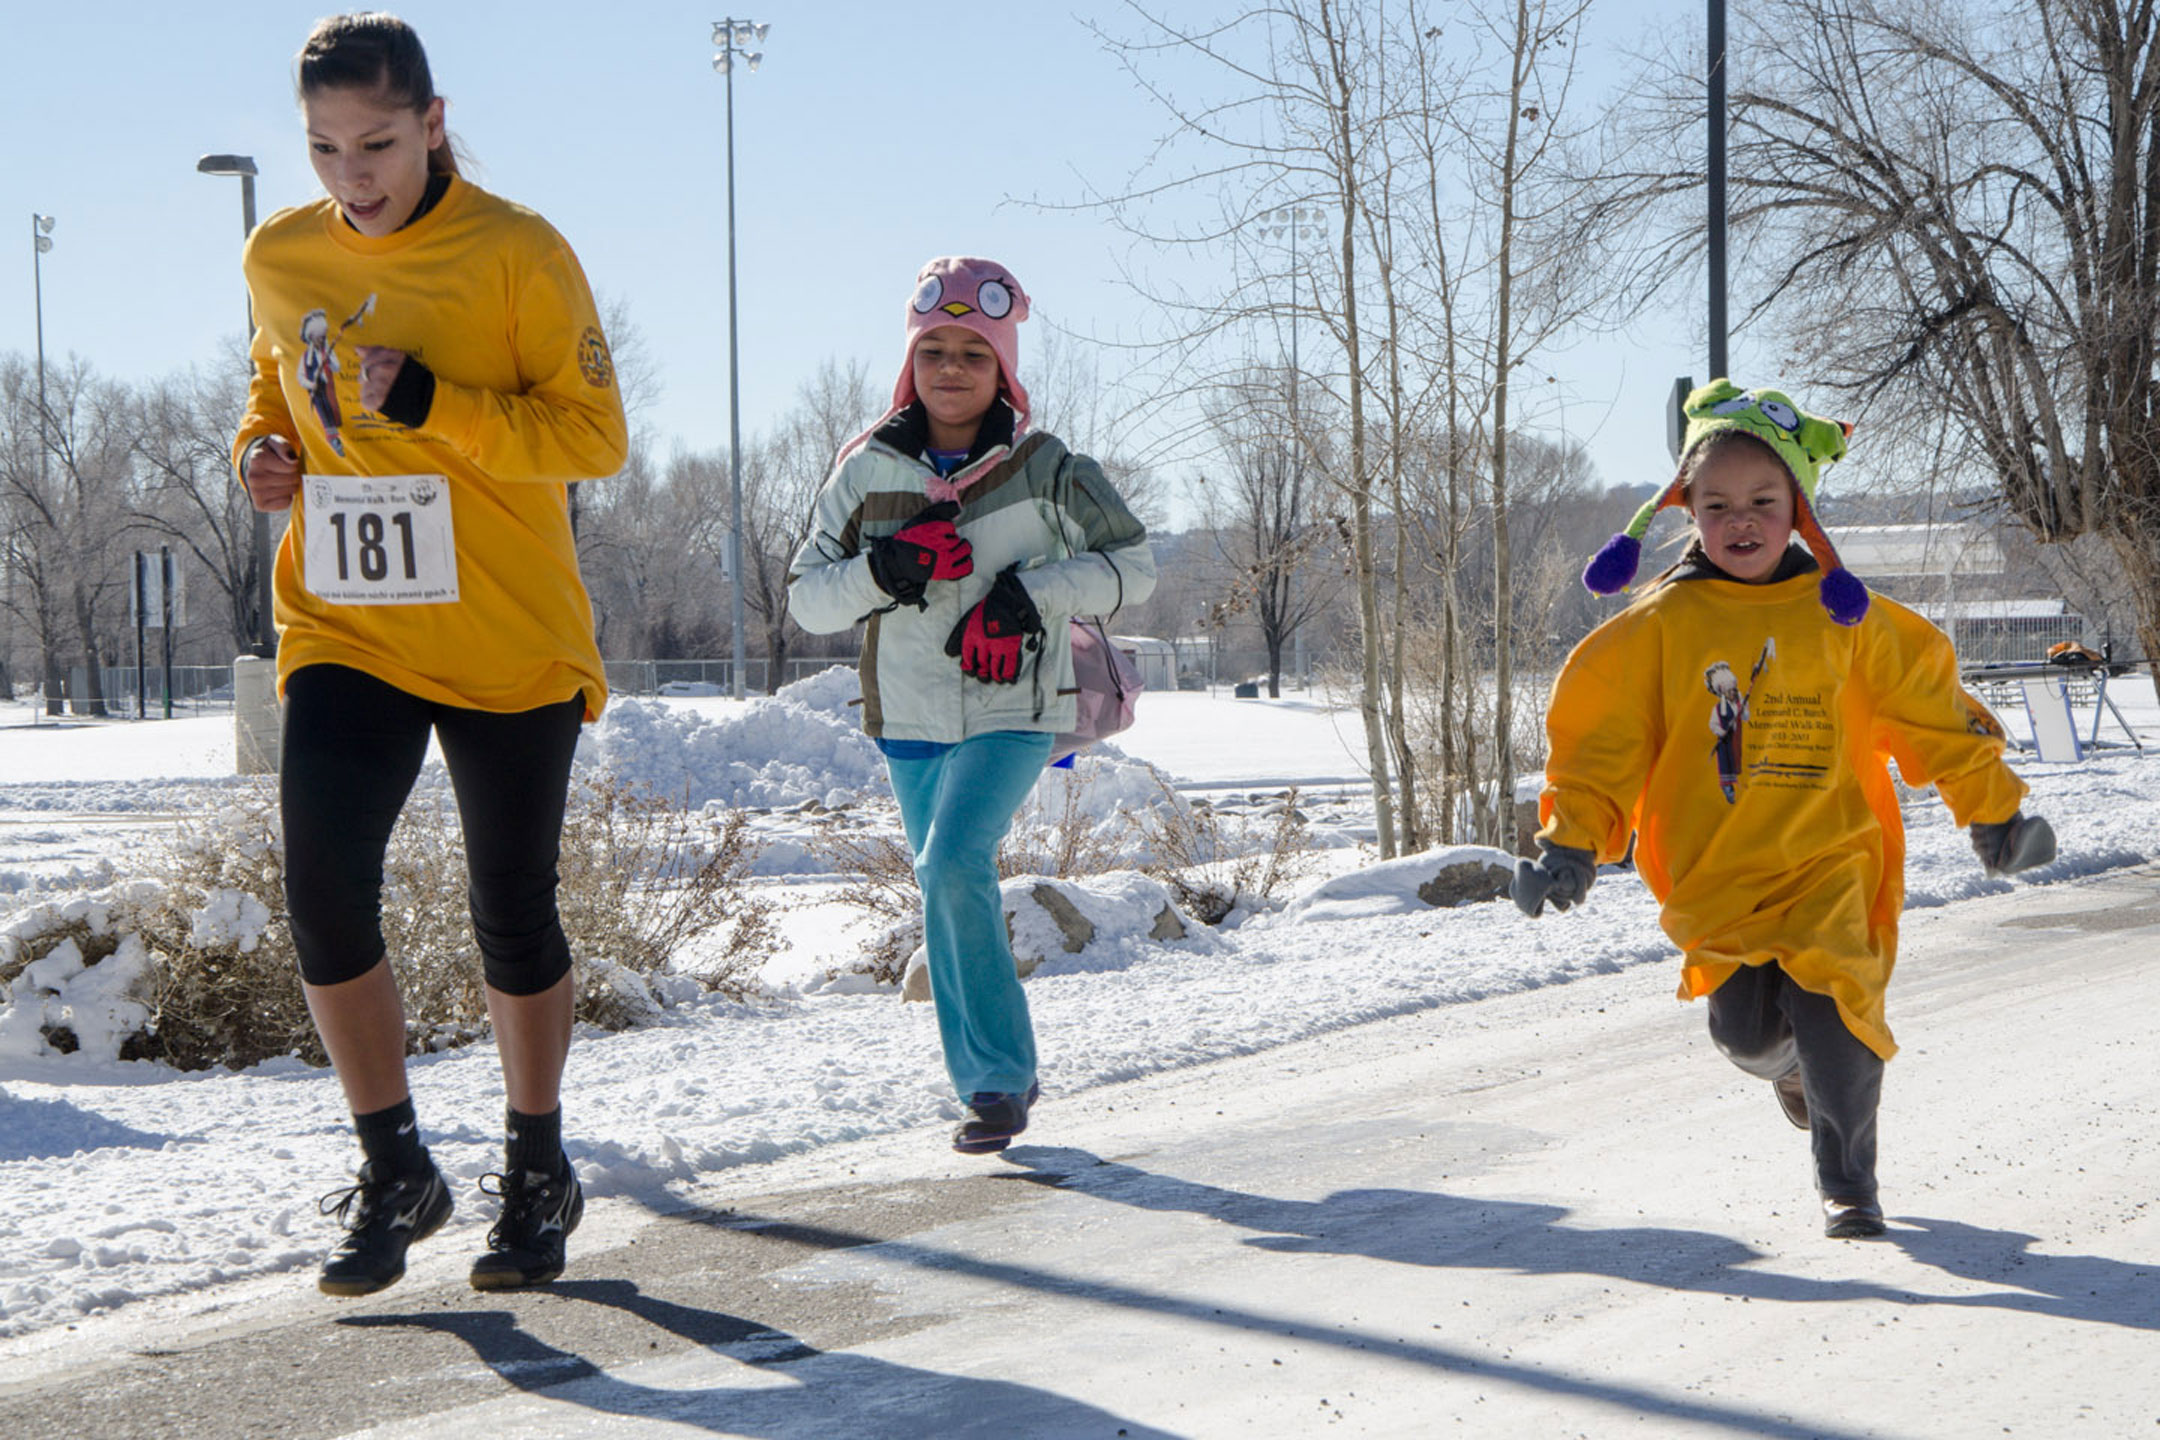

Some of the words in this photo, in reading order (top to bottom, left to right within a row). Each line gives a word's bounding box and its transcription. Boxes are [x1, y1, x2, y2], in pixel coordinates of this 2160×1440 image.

[330, 512, 416, 581] 181
[1764, 692, 1783, 705] 2nd
[1786, 692, 1821, 705] Annual
[1790, 720, 1812, 730] Walk
